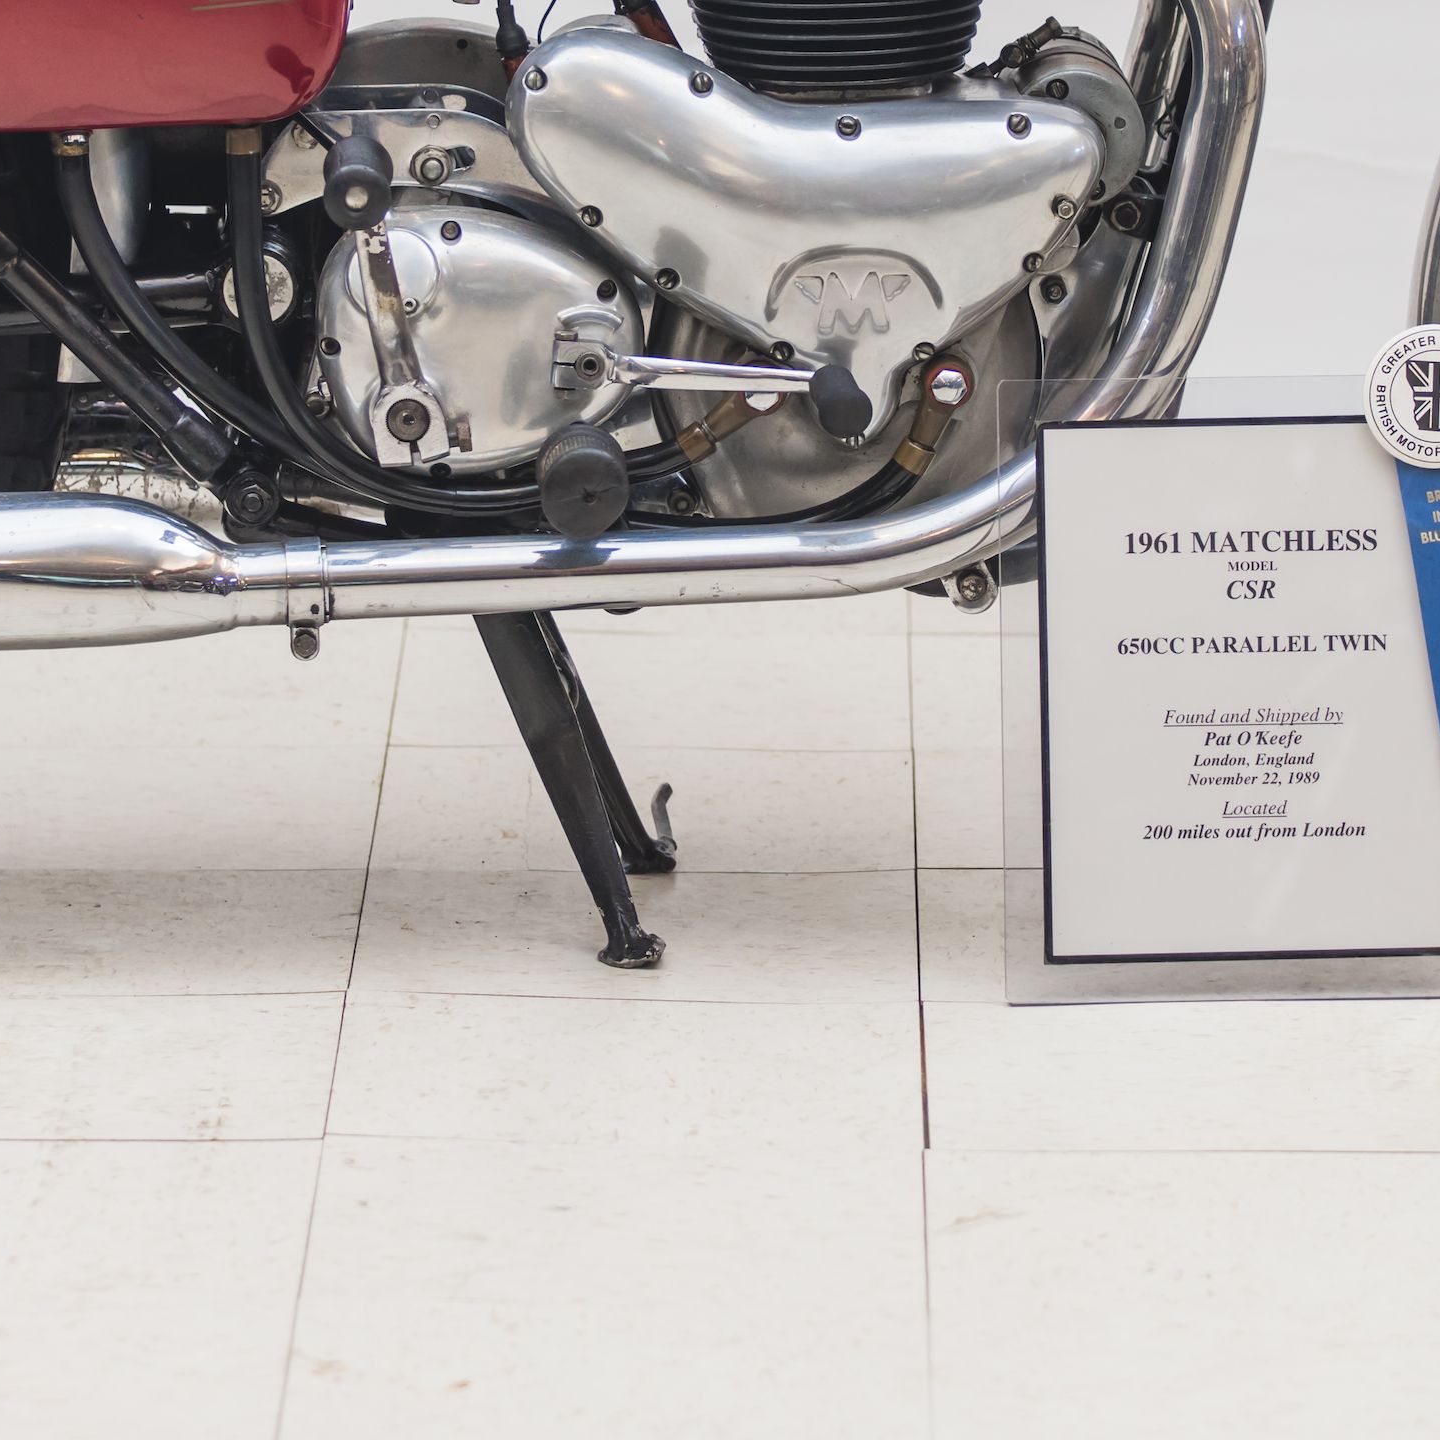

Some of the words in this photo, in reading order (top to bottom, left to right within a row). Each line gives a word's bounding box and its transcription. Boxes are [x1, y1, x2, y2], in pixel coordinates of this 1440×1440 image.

[1381, 335, 1436, 374] GREATER
[1376, 385, 1398, 436] BRITISH
[1124, 531, 1182, 554] 1961
[1190, 528, 1378, 553] MATCHLESS
[1227, 560, 1278, 572] MODEL
[1226, 579, 1277, 600] CSR
[1117, 636, 1185, 655] 650CC
[1191, 635, 1318, 654] PARALLEL
[1324, 633, 1388, 652] TWIN
[1164, 709, 1216, 724] Found
[1220, 708, 1251, 723] and
[1255, 707, 1320, 726] Shipped
[1324, 707, 1344, 725] by
[1203, 731, 1232, 747] Pat
[1192, 754, 1250, 768] London,
[1255, 752, 1315, 768] England
[1187, 772, 1258, 786] November
[1261, 771, 1282, 787] 22,
[1287, 771, 1320, 785] 1989
[1222, 800, 1288, 816] Located
[1142, 825, 1173, 840] 200
[1178, 824, 1220, 839] miles
[1225, 825, 1253, 838] out
[1254, 823, 1297, 842] from
[1302, 822, 1366, 838] London
